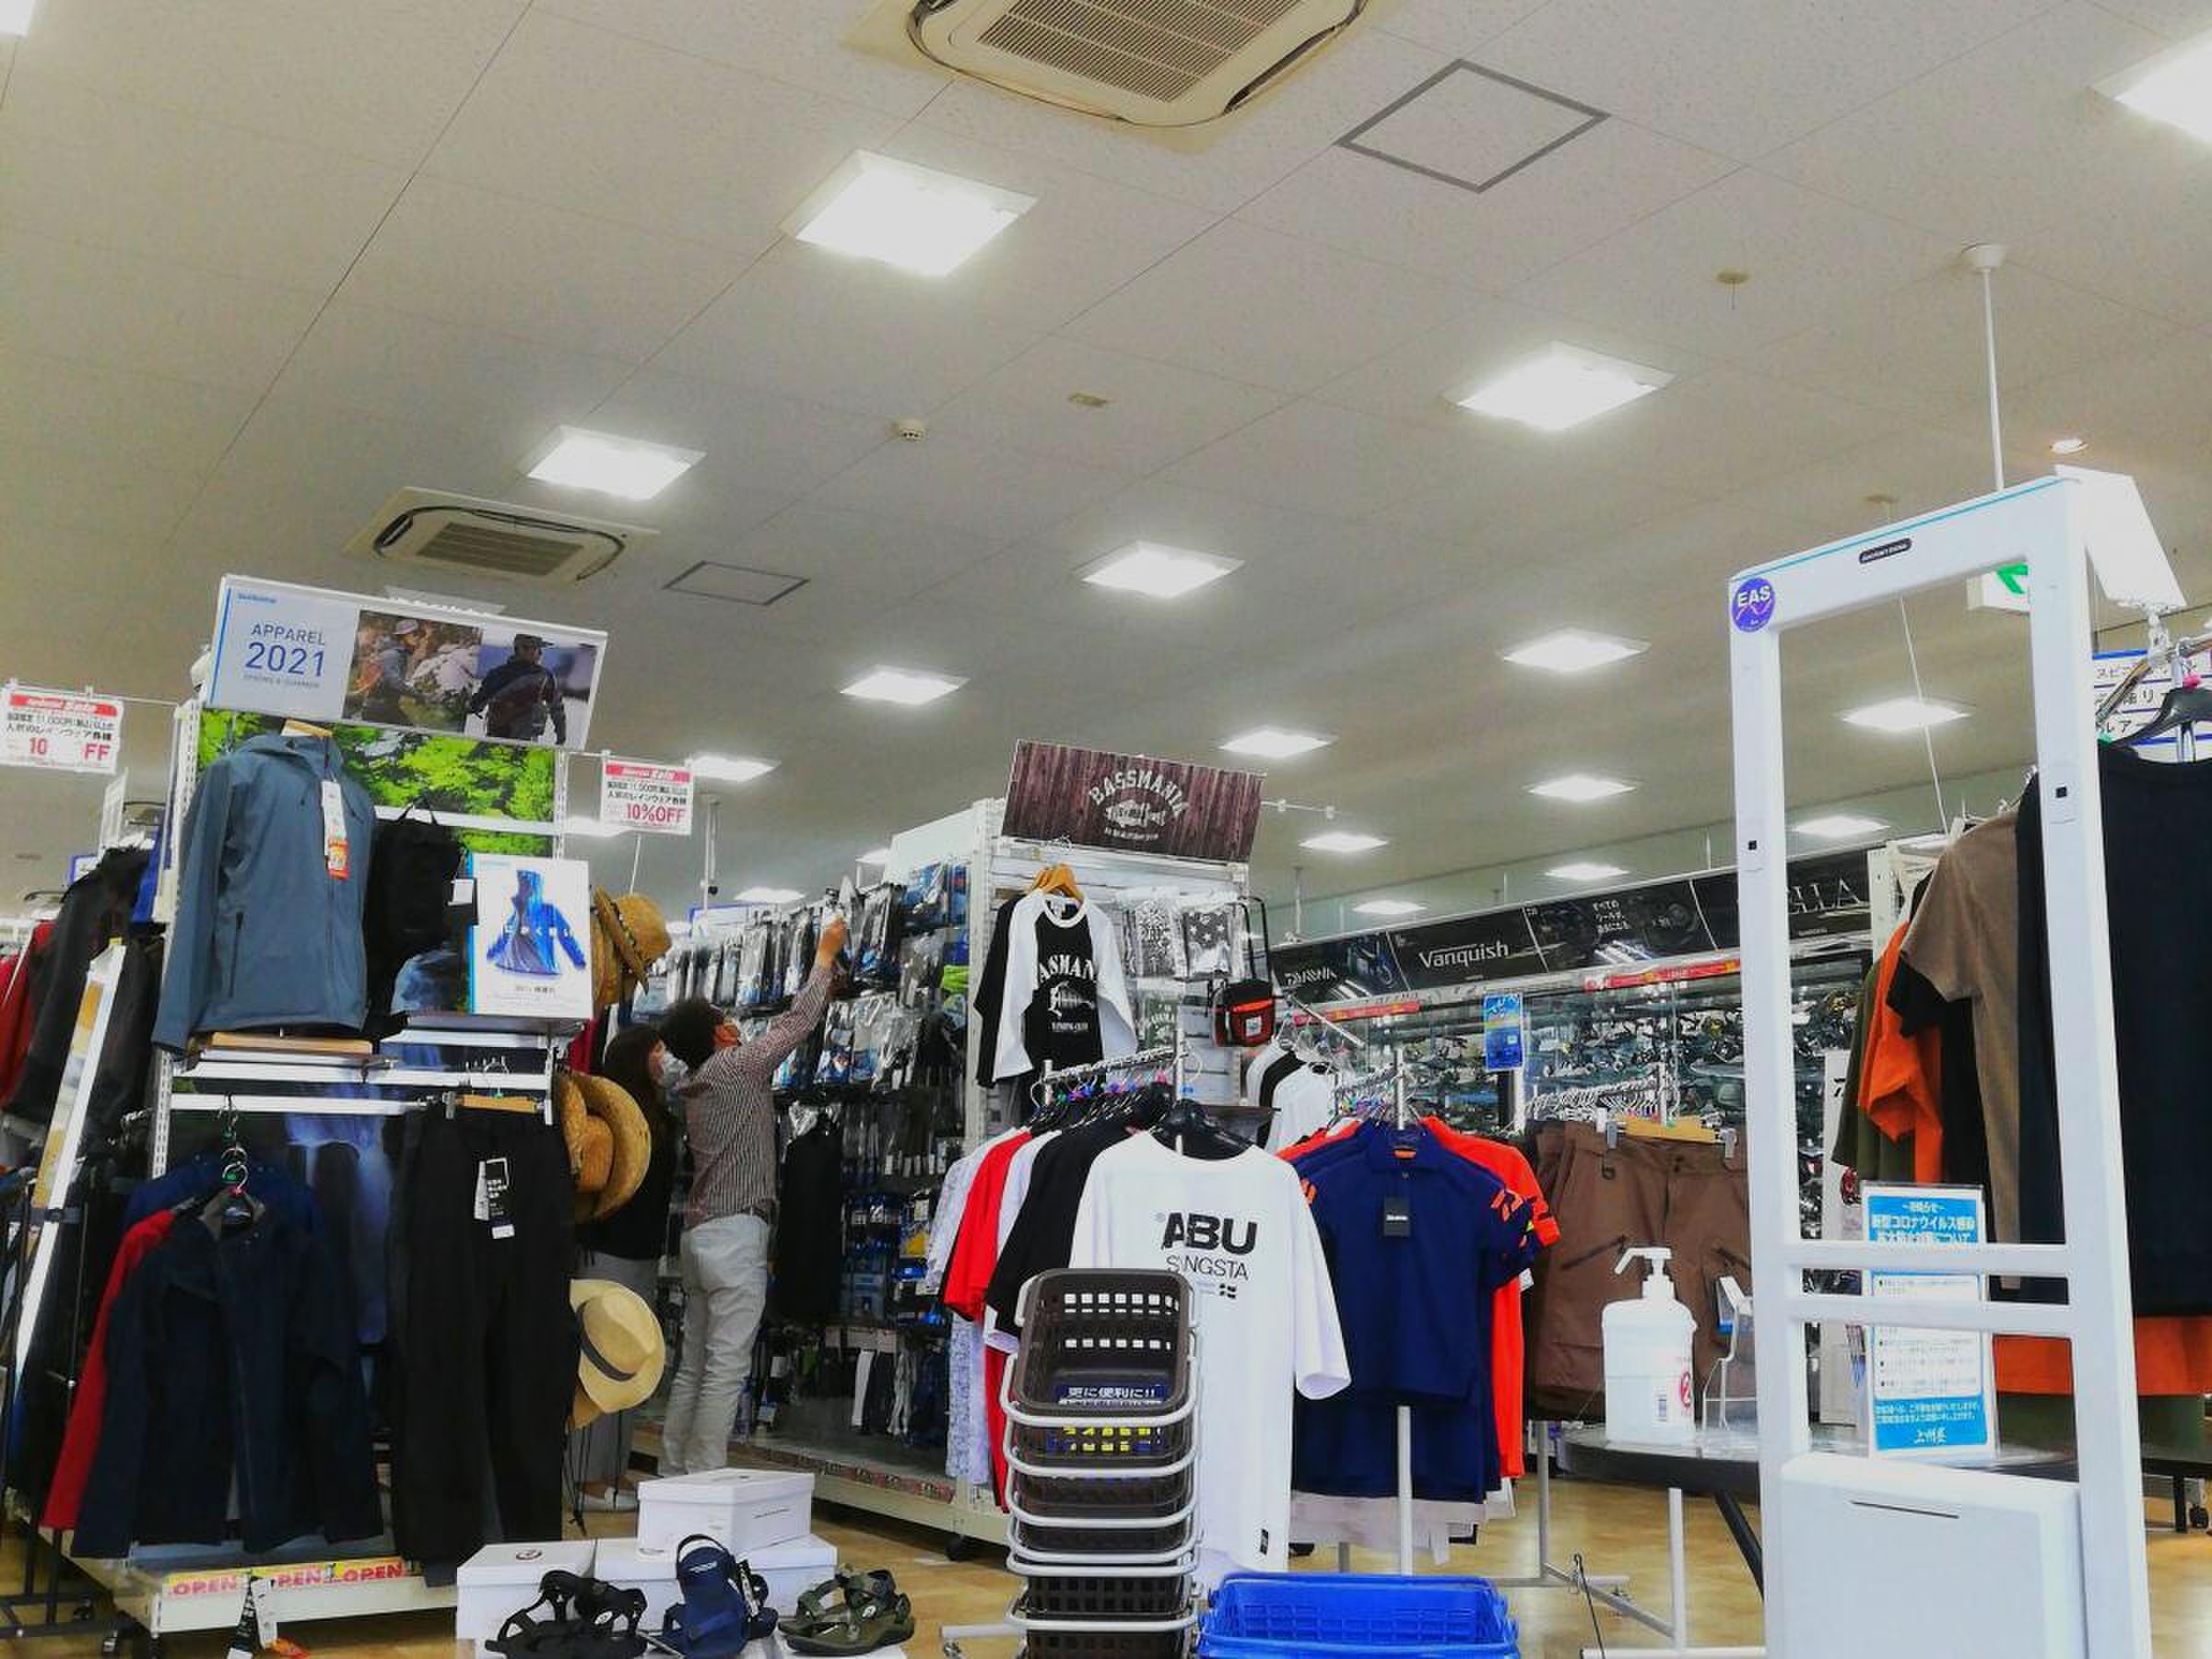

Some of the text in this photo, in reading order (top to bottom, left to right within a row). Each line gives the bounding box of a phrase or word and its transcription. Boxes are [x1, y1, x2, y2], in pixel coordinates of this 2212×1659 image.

[1737, 584, 1771, 608] EAS
[251, 623, 325, 646] APPAREL
[244, 641, 324, 677] 2021
[1089, 770, 1189, 818] BASSMANIA
[627, 803, 688, 822] 10%OFF
[1418, 940, 1509, 968] Vanquish
[1161, 1212, 1258, 1255] ABU
[342, 1562, 403, 1583] OPEN
[171, 1575, 237, 1595] OPEN
